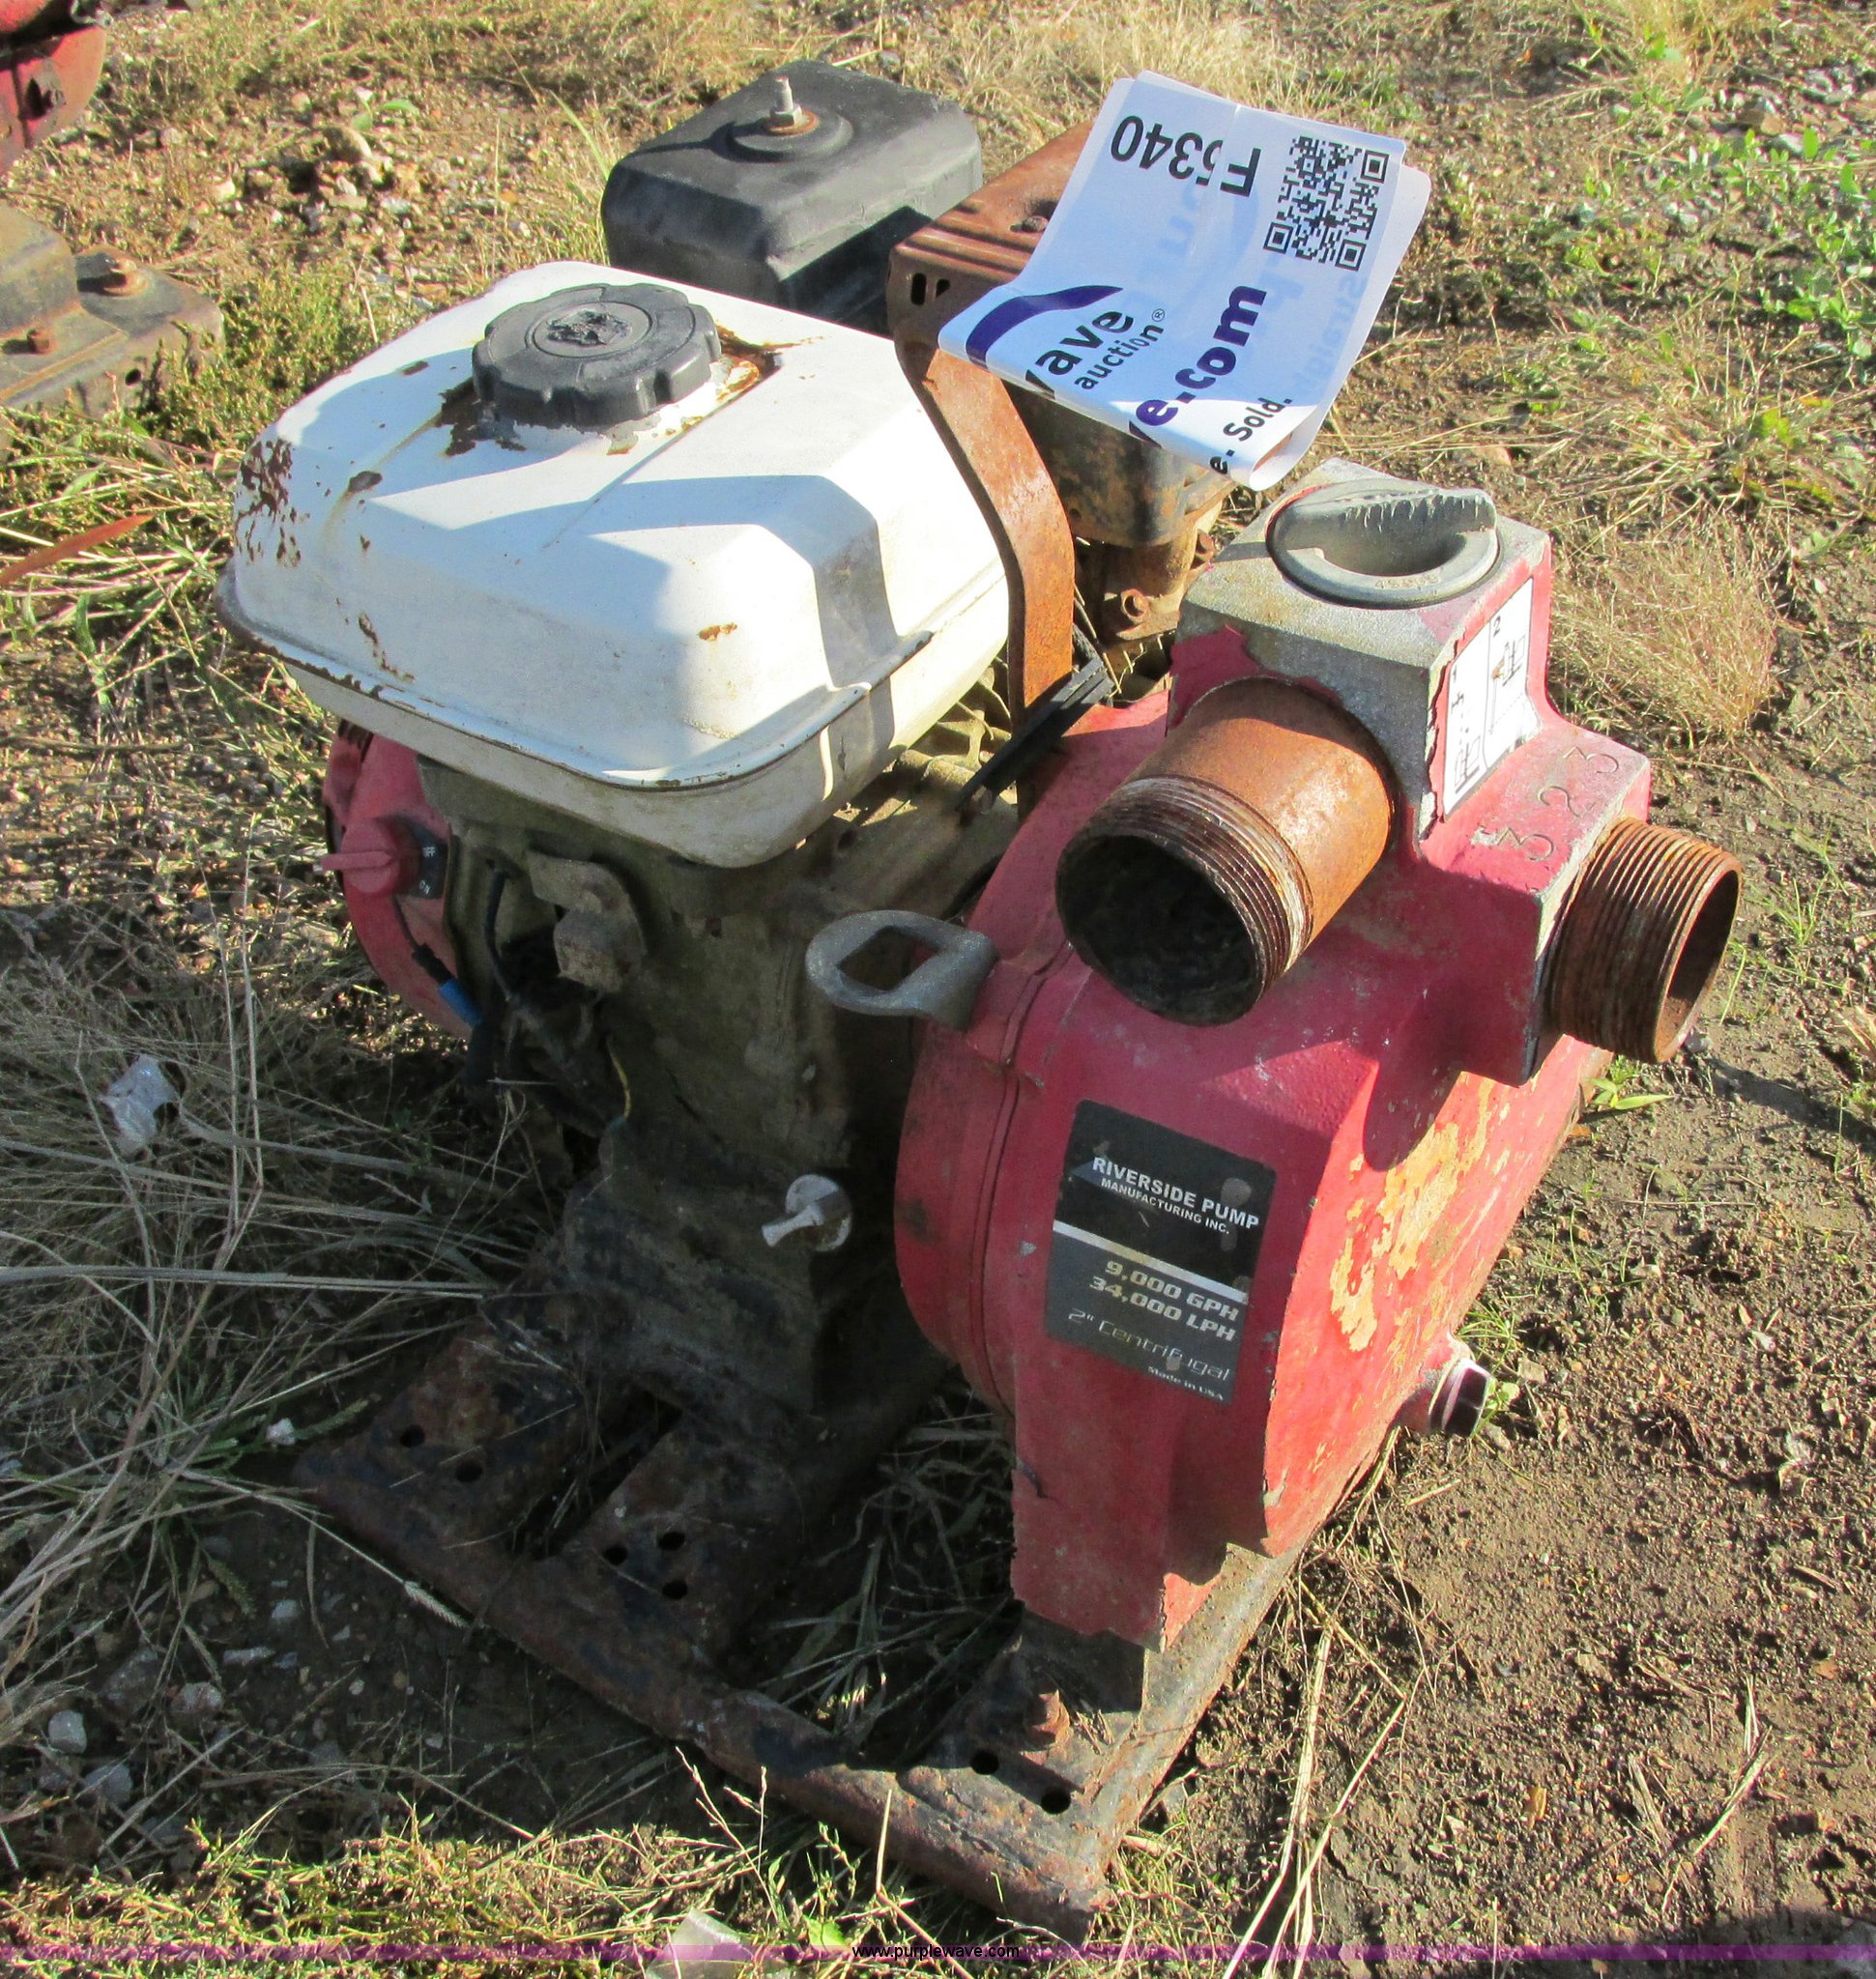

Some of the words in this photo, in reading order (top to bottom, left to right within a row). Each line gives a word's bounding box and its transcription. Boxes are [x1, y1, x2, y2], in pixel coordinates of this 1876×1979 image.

[1223, 396, 1293, 443] Sold.
[1092, 1156, 1197, 1209] RIVERSIDE
[1200, 1196, 1260, 1230] PUMP
[1101, 1177, 1202, 1224] MANUFACTURING
[1204, 1217, 1230, 1235] INC.
[1088, 1275, 1183, 1321] 34,000
[1185, 1312, 1237, 1342] LPH
[1105, 1259, 1183, 1300] 9,000
[1186, 1290, 1240, 1322] GPH
[1147, 1364, 1182, 1385] Made
[1184, 1380, 1197, 1390] in
[1198, 1386, 1225, 1401] USA
